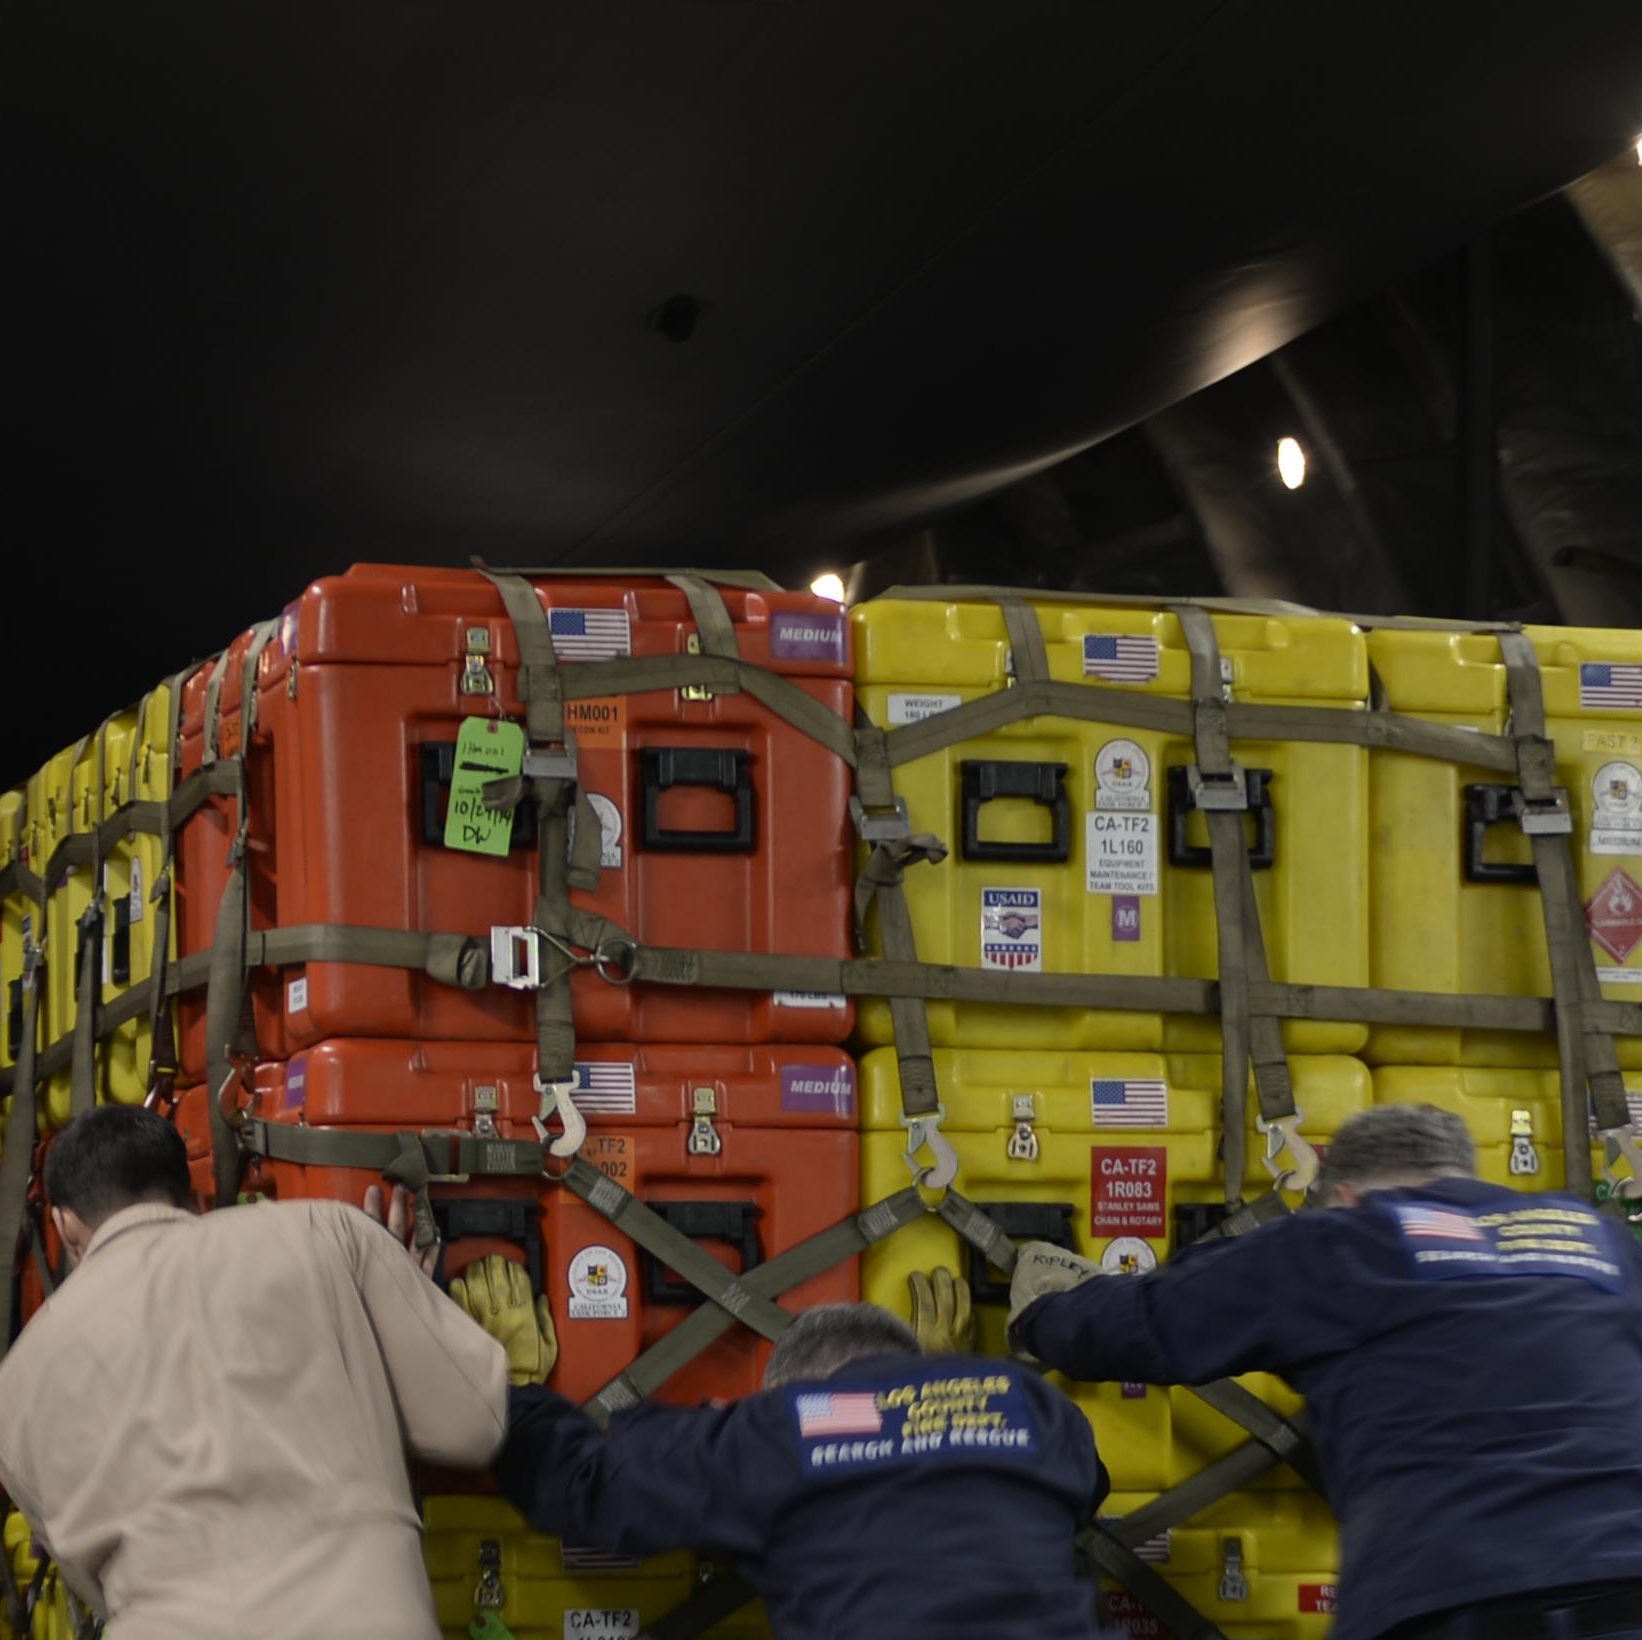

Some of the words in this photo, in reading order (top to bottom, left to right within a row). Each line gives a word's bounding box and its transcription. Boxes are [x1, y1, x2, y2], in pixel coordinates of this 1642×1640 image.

[779, 627, 843, 643] MEDIUM
[904, 698, 943, 708] WEIGHT
[566, 704, 619, 721] HM001
[1588, 732, 1625, 748] FAST
[1094, 816, 1149, 832] CA-TF2
[1101, 839, 1144, 855] 1L160
[1099, 859, 1145, 868] EQUIPMENT
[1089, 881, 1112, 890] TEAM
[1114, 881, 1135, 890] TOOL
[1137, 882, 1155, 891] KITS
[988, 892, 1035, 905] USAID
[1118, 909, 1137, 928] M
[790, 1079, 852, 1096] MEDIUM
[1100, 1157, 1157, 1176] CA-TF2
[1106, 1181, 1143, 1198] 1R083
[1097, 1201, 1134, 1211] STANLEY
[1137, 1202, 1160, 1212] SAWS
[1093, 1215, 1120, 1225] CHAIN
[1130, 1216, 1162, 1226] ROTARY
[811, 1438, 894, 1467] SEARCH
[901, 1431, 944, 1455] AND
[949, 1427, 1030, 1447] RESCUE
[570, 1610, 631, 1629] CA-TF2
